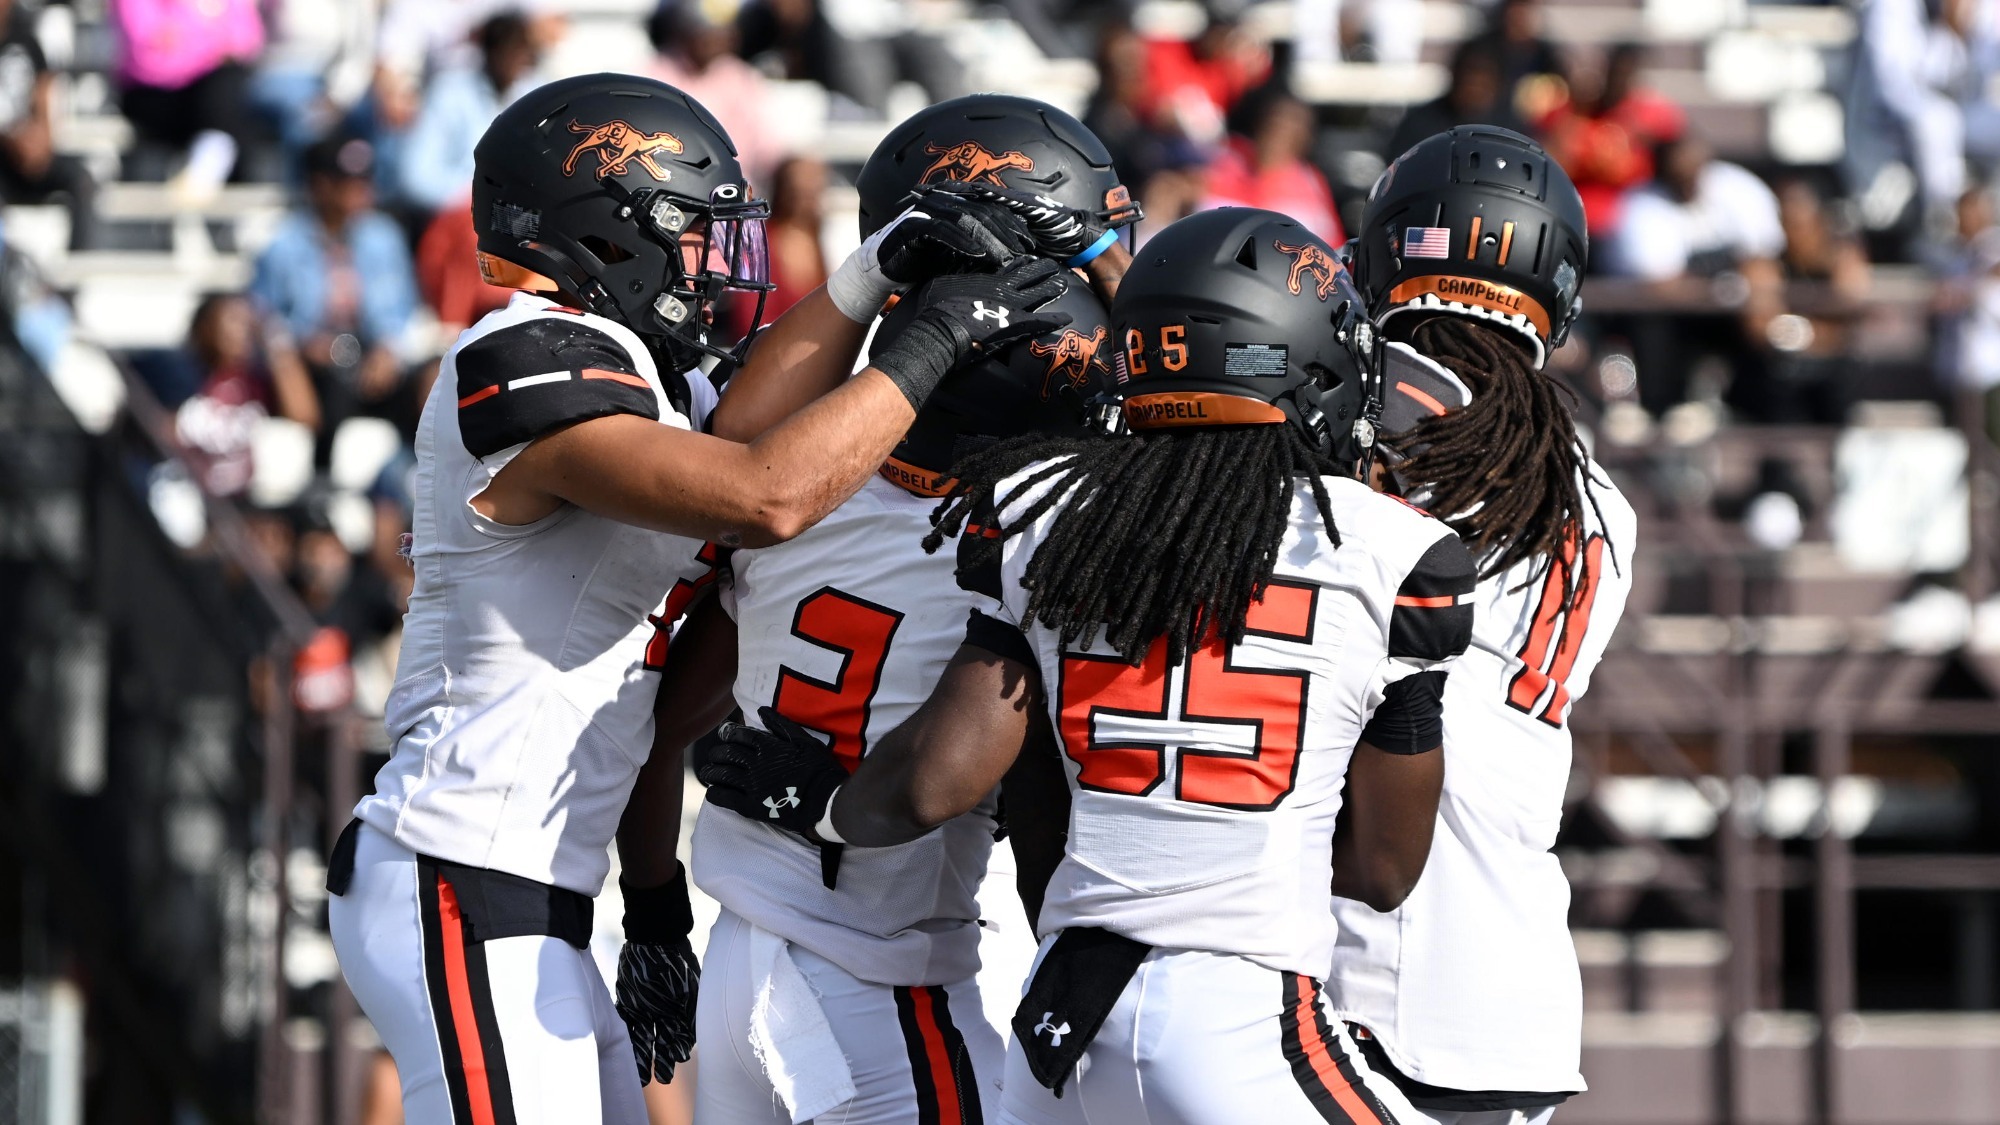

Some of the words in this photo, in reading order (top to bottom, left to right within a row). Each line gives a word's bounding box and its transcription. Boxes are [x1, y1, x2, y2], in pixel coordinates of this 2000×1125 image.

[1437, 278, 1521, 310] CAMPBELL
[1126, 327, 1188, 375] 25
[1129, 402, 1208, 421] CAMPBELL
[883, 462, 940, 493] MPBELL
[1504, 519, 1605, 729] 11
